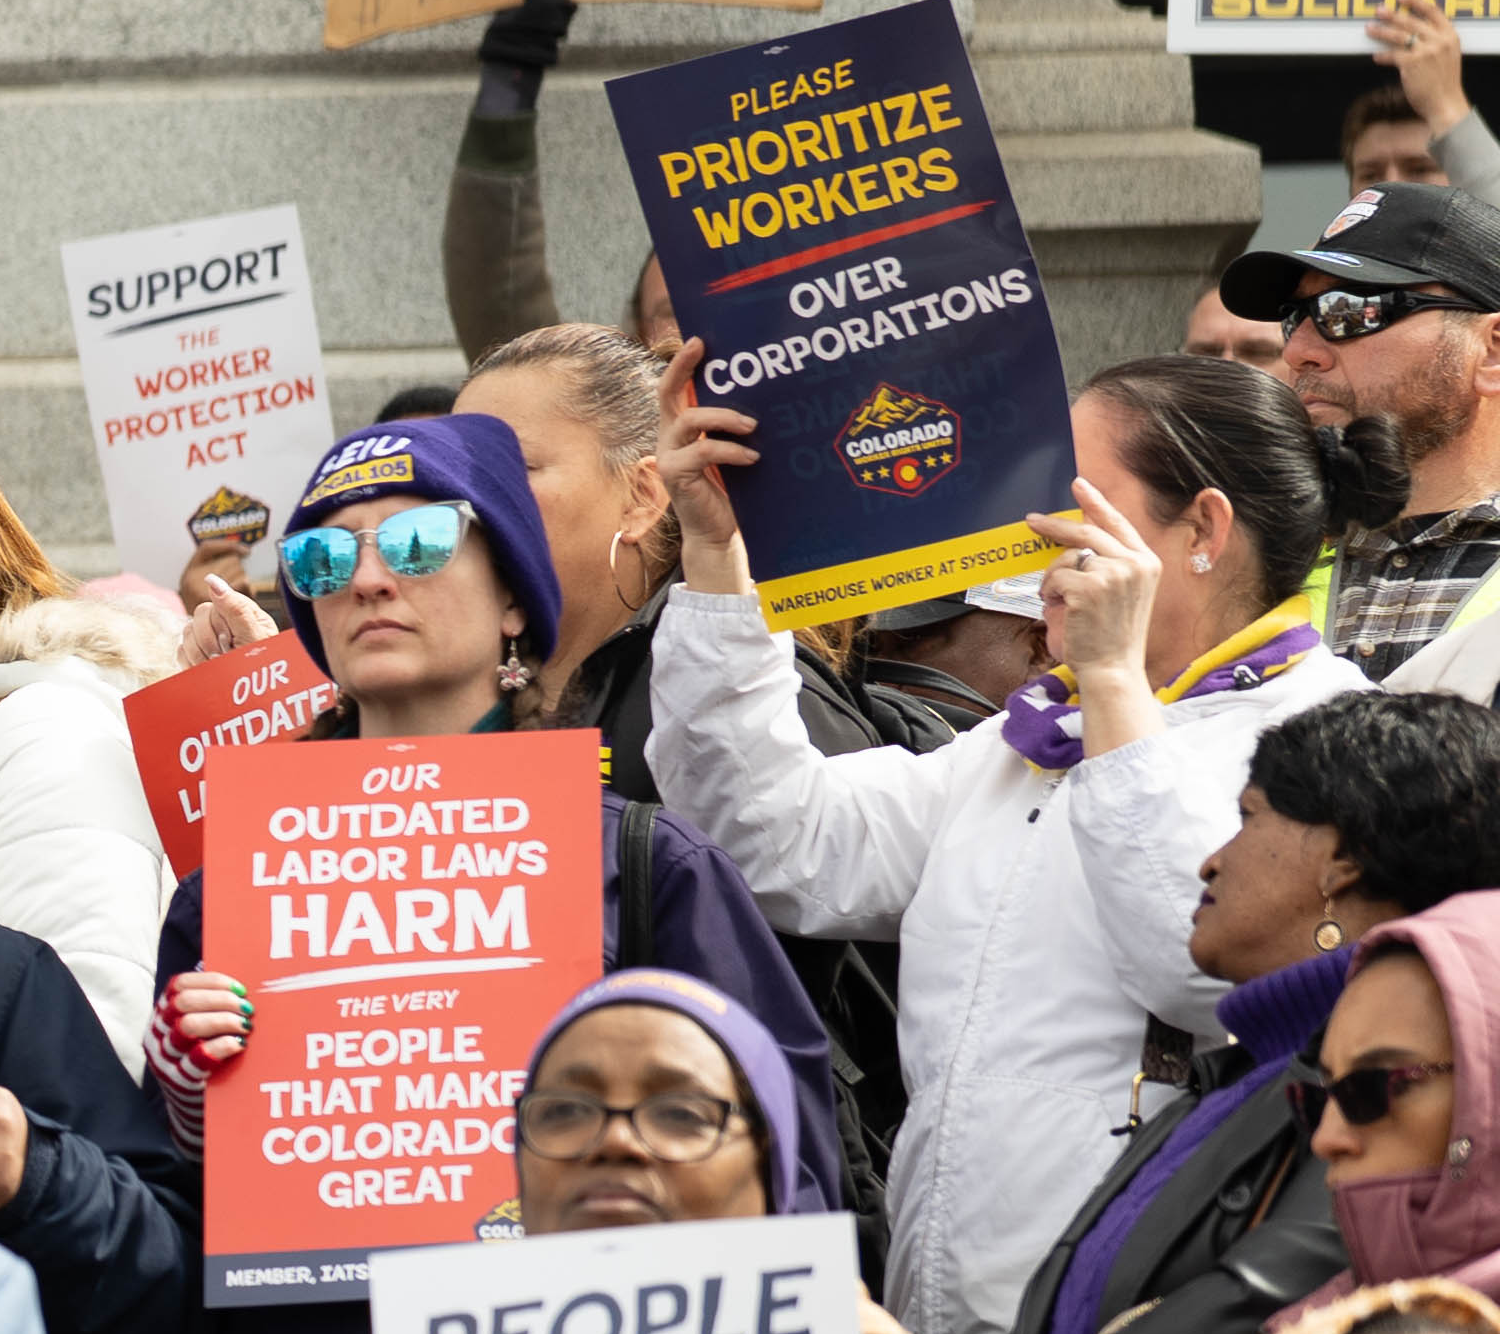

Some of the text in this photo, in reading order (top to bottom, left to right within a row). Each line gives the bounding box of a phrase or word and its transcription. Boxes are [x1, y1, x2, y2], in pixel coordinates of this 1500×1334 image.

[729, 59, 856, 123] PLEASE
[658, 83, 963, 199] PRIORITIZE
[693, 148, 960, 250] WORKERS
[86, 241, 291, 320] SUPPORT
[787, 254, 908, 320] OVER
[177, 327, 222, 352] THE
[703, 267, 1034, 396] CORPORATIONS
[134, 345, 273, 402] WORKER
[104, 373, 316, 448] PROTECTION
[186, 430, 248, 471] ACT
[845, 420, 953, 457] COLORADO
[369, 460, 408, 479] 105
[770, 580, 868, 615] WAREHOUSE
[871, 565, 935, 591] WORKER
[937, 559, 956, 578] AT
[960, 546, 1009, 571] SYSCO
[232, 660, 290, 706] OUR
[361, 763, 441, 795] OUR
[268, 797, 530, 842] OUTDATED
[252, 840, 548, 888] LABOR LAWS
[269, 885, 534, 960] HARM
[336, 988, 459, 1019] THE VERY
[305, 1026, 484, 1070] PEOPLE
[260, 1077, 384, 1119] THAT
[318, 1164, 473, 1209] GREAT
[225, 1261, 369, 1290] MEMBER, IATS
